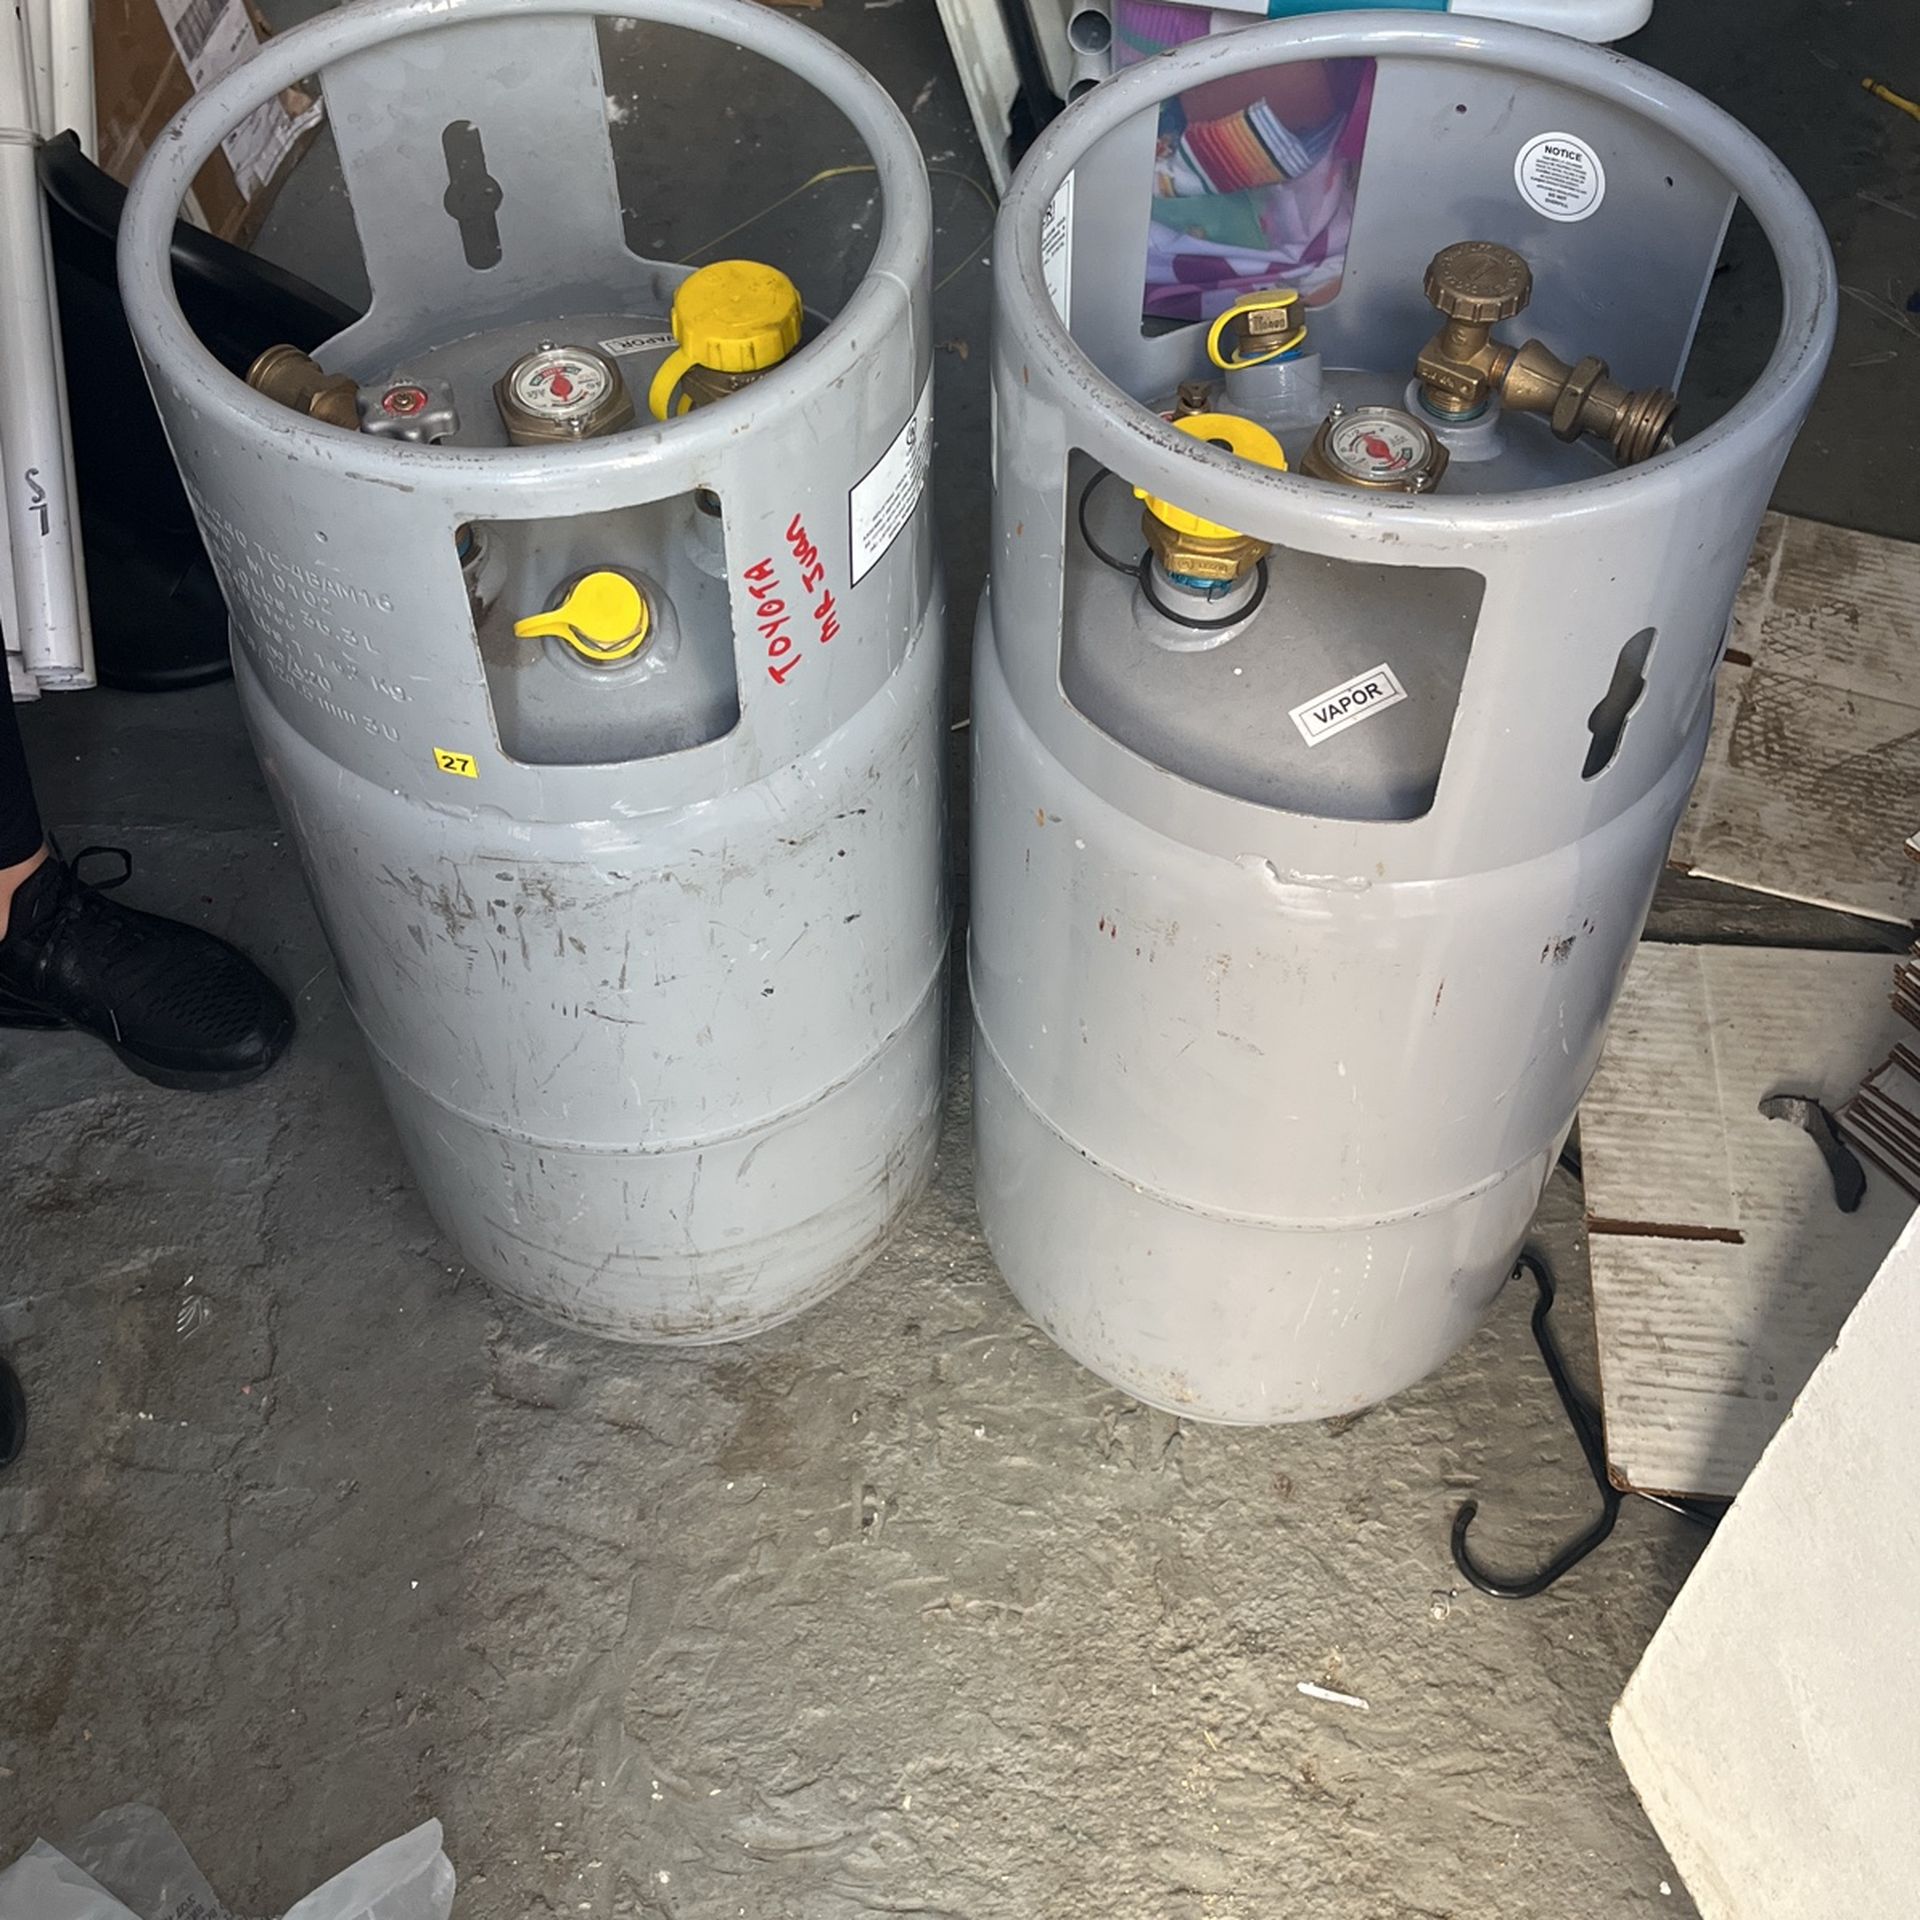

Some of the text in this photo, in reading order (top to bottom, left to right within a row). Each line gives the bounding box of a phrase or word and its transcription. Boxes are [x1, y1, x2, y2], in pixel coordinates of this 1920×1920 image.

[1544, 145, 1583, 162] NOTICE
[744, 557, 802, 684] TOYOTA
[814, 589, 840, 643] MR
[1313, 683, 1383, 723] VAPOR
[441, 755, 469, 772] 27
